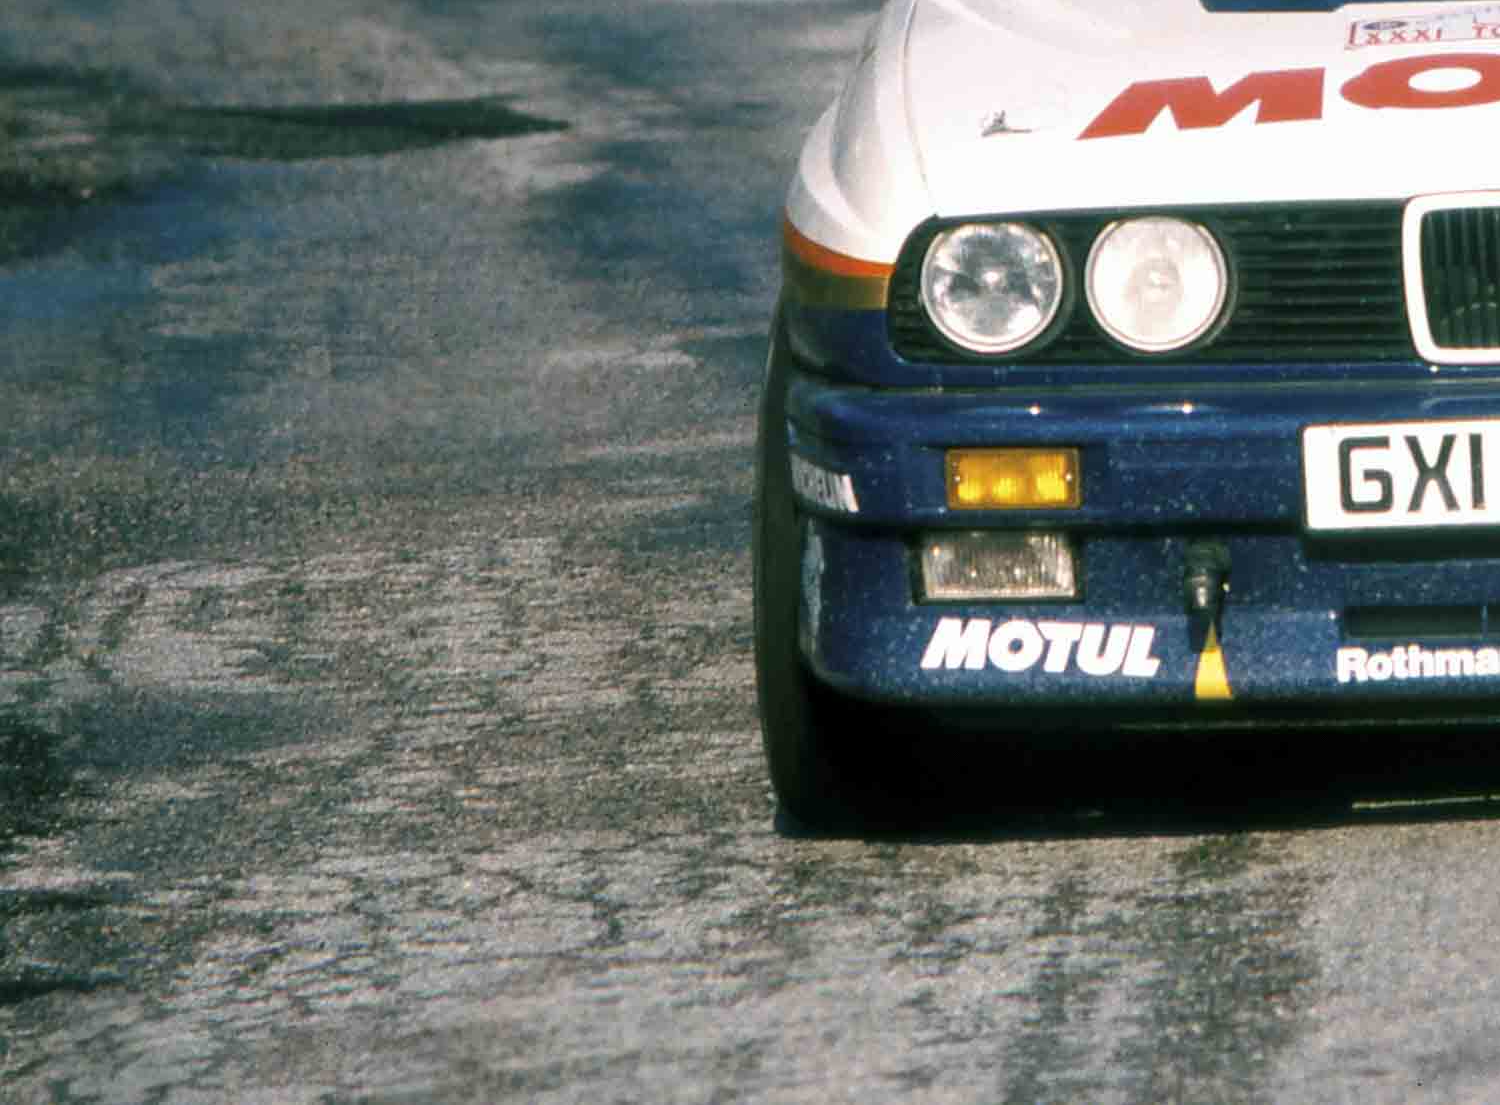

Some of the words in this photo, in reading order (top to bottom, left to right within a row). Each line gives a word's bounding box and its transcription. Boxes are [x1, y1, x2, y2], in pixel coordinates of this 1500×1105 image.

[1366, 29, 1443, 46] XXXI
[1337, 433, 1486, 514] GXI
[920, 618, 1161, 677] MOTUL
